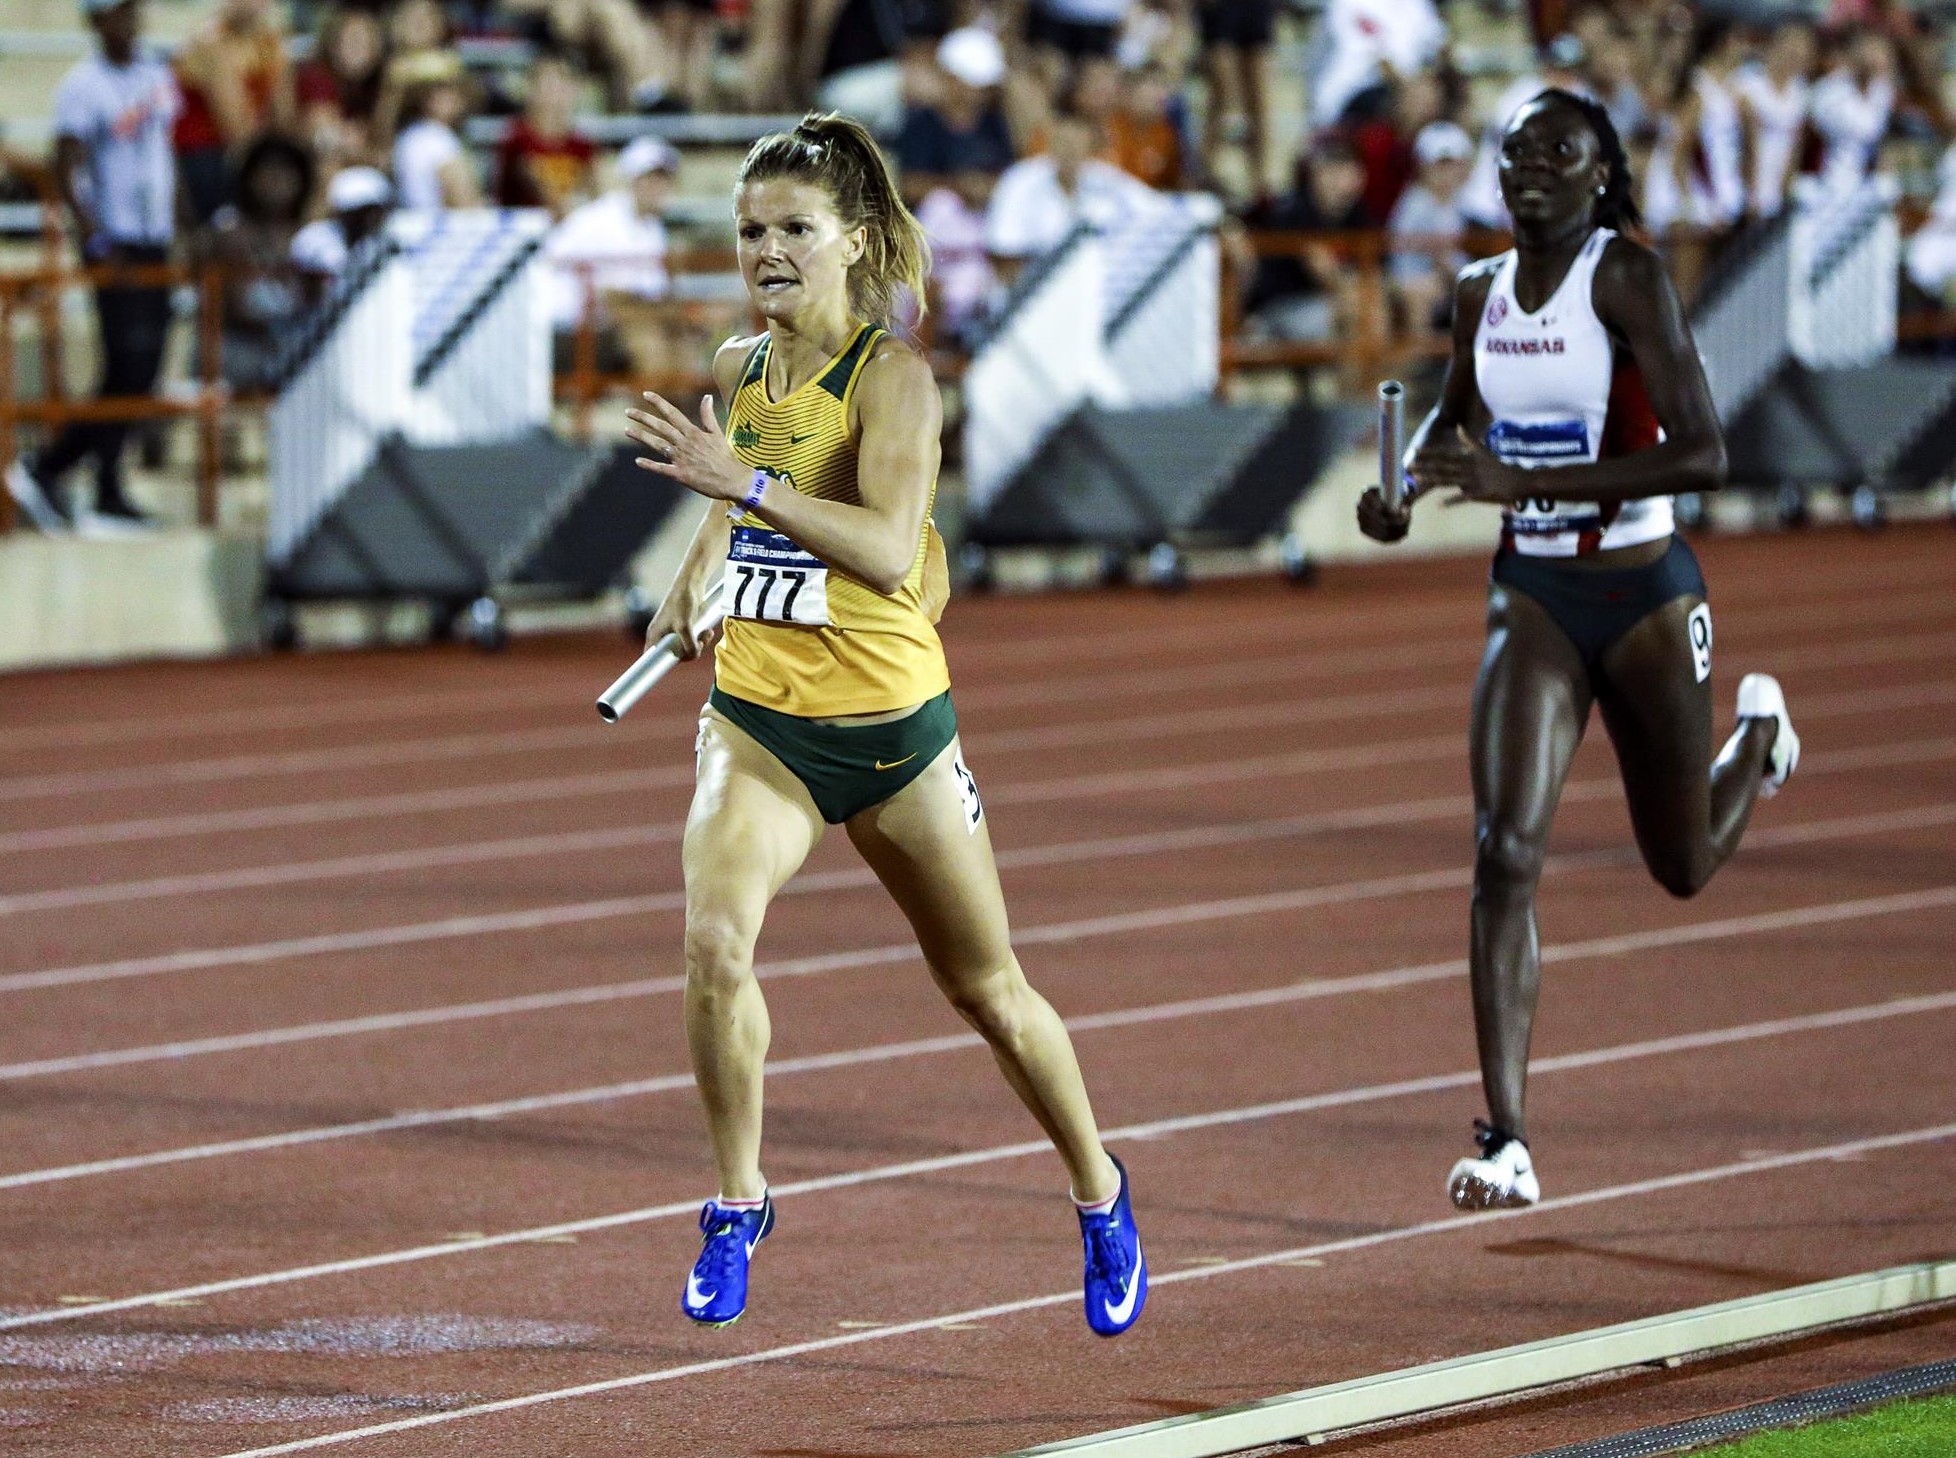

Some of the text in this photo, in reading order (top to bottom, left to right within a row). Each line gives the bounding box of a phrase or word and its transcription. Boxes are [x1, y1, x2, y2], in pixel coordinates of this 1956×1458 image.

[1486, 337, 1565, 355] ARKANSAS
[734, 565, 806, 621] 777
[1692, 615, 1711, 669] 9
